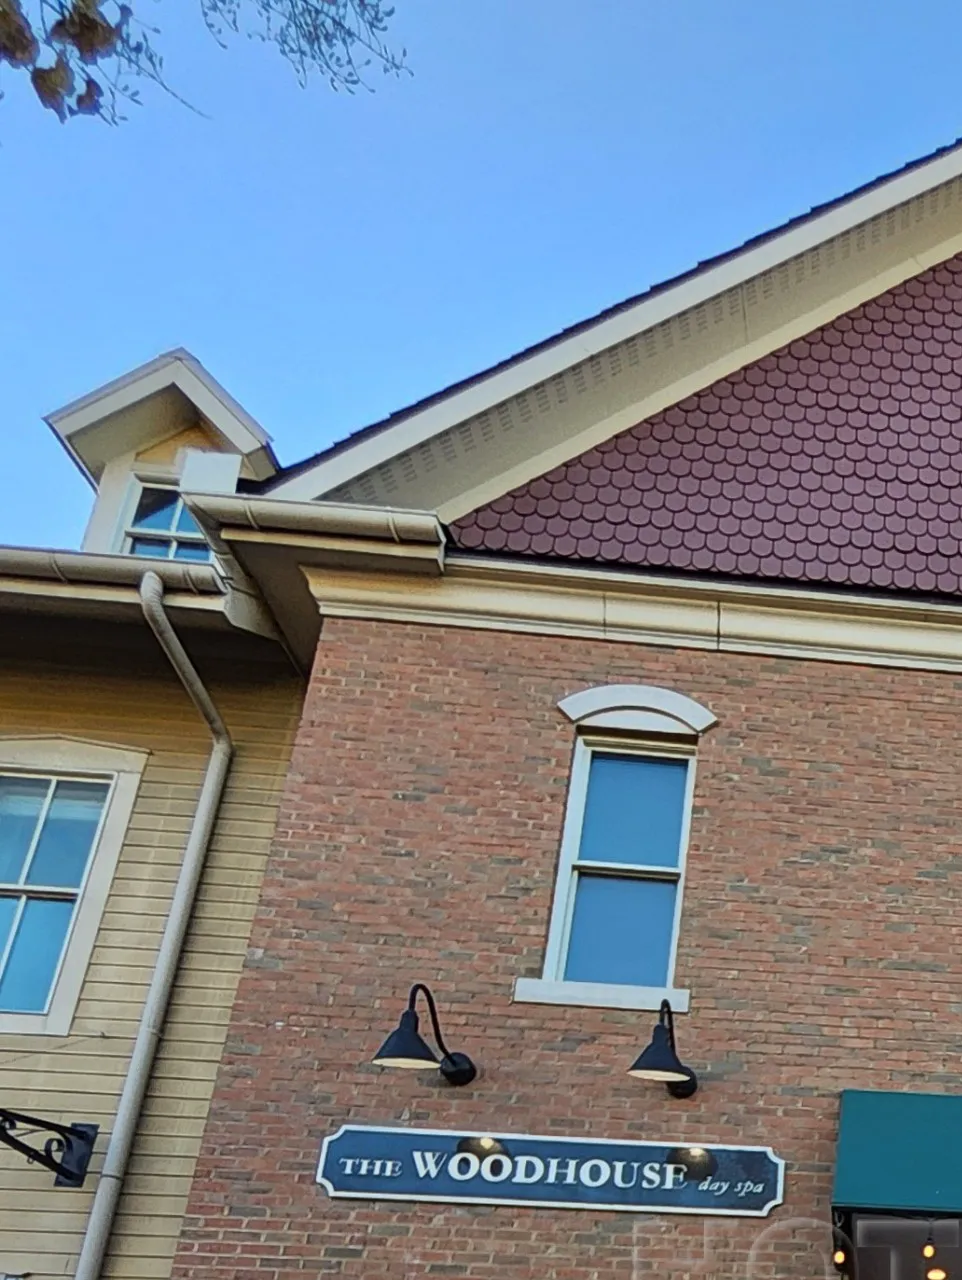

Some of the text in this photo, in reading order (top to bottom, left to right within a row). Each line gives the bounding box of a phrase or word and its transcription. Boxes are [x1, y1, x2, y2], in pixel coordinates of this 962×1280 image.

[340, 1150, 764, 1196] THE WOODHOUSE day spa
